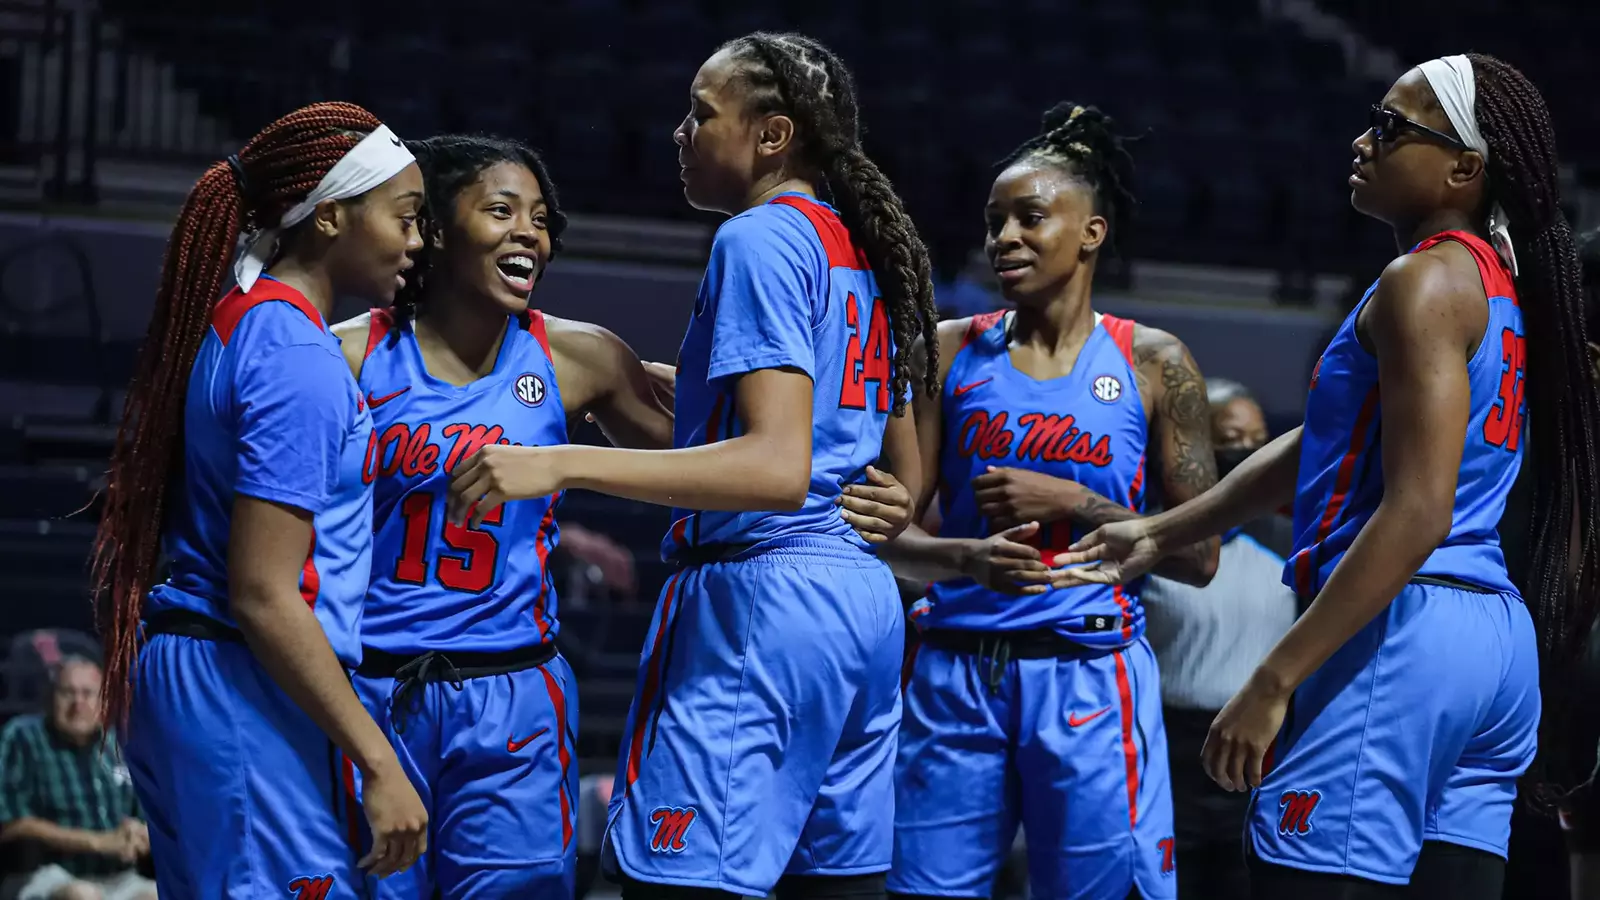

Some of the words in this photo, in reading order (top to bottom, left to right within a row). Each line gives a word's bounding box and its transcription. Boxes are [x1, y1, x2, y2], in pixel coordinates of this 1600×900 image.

[838, 290, 891, 414] 24
[516, 376, 543, 402] SEC
[1094, 376, 1121, 401] SEC
[377, 422, 440, 477] Ole
[958, 410, 1013, 460] Ole
[1016, 412, 1113, 466] Miss
[395, 491, 505, 595] 15
[1095, 617, 1105, 628] S
[650, 805, 698, 852] M
[1279, 789, 1322, 835] M
